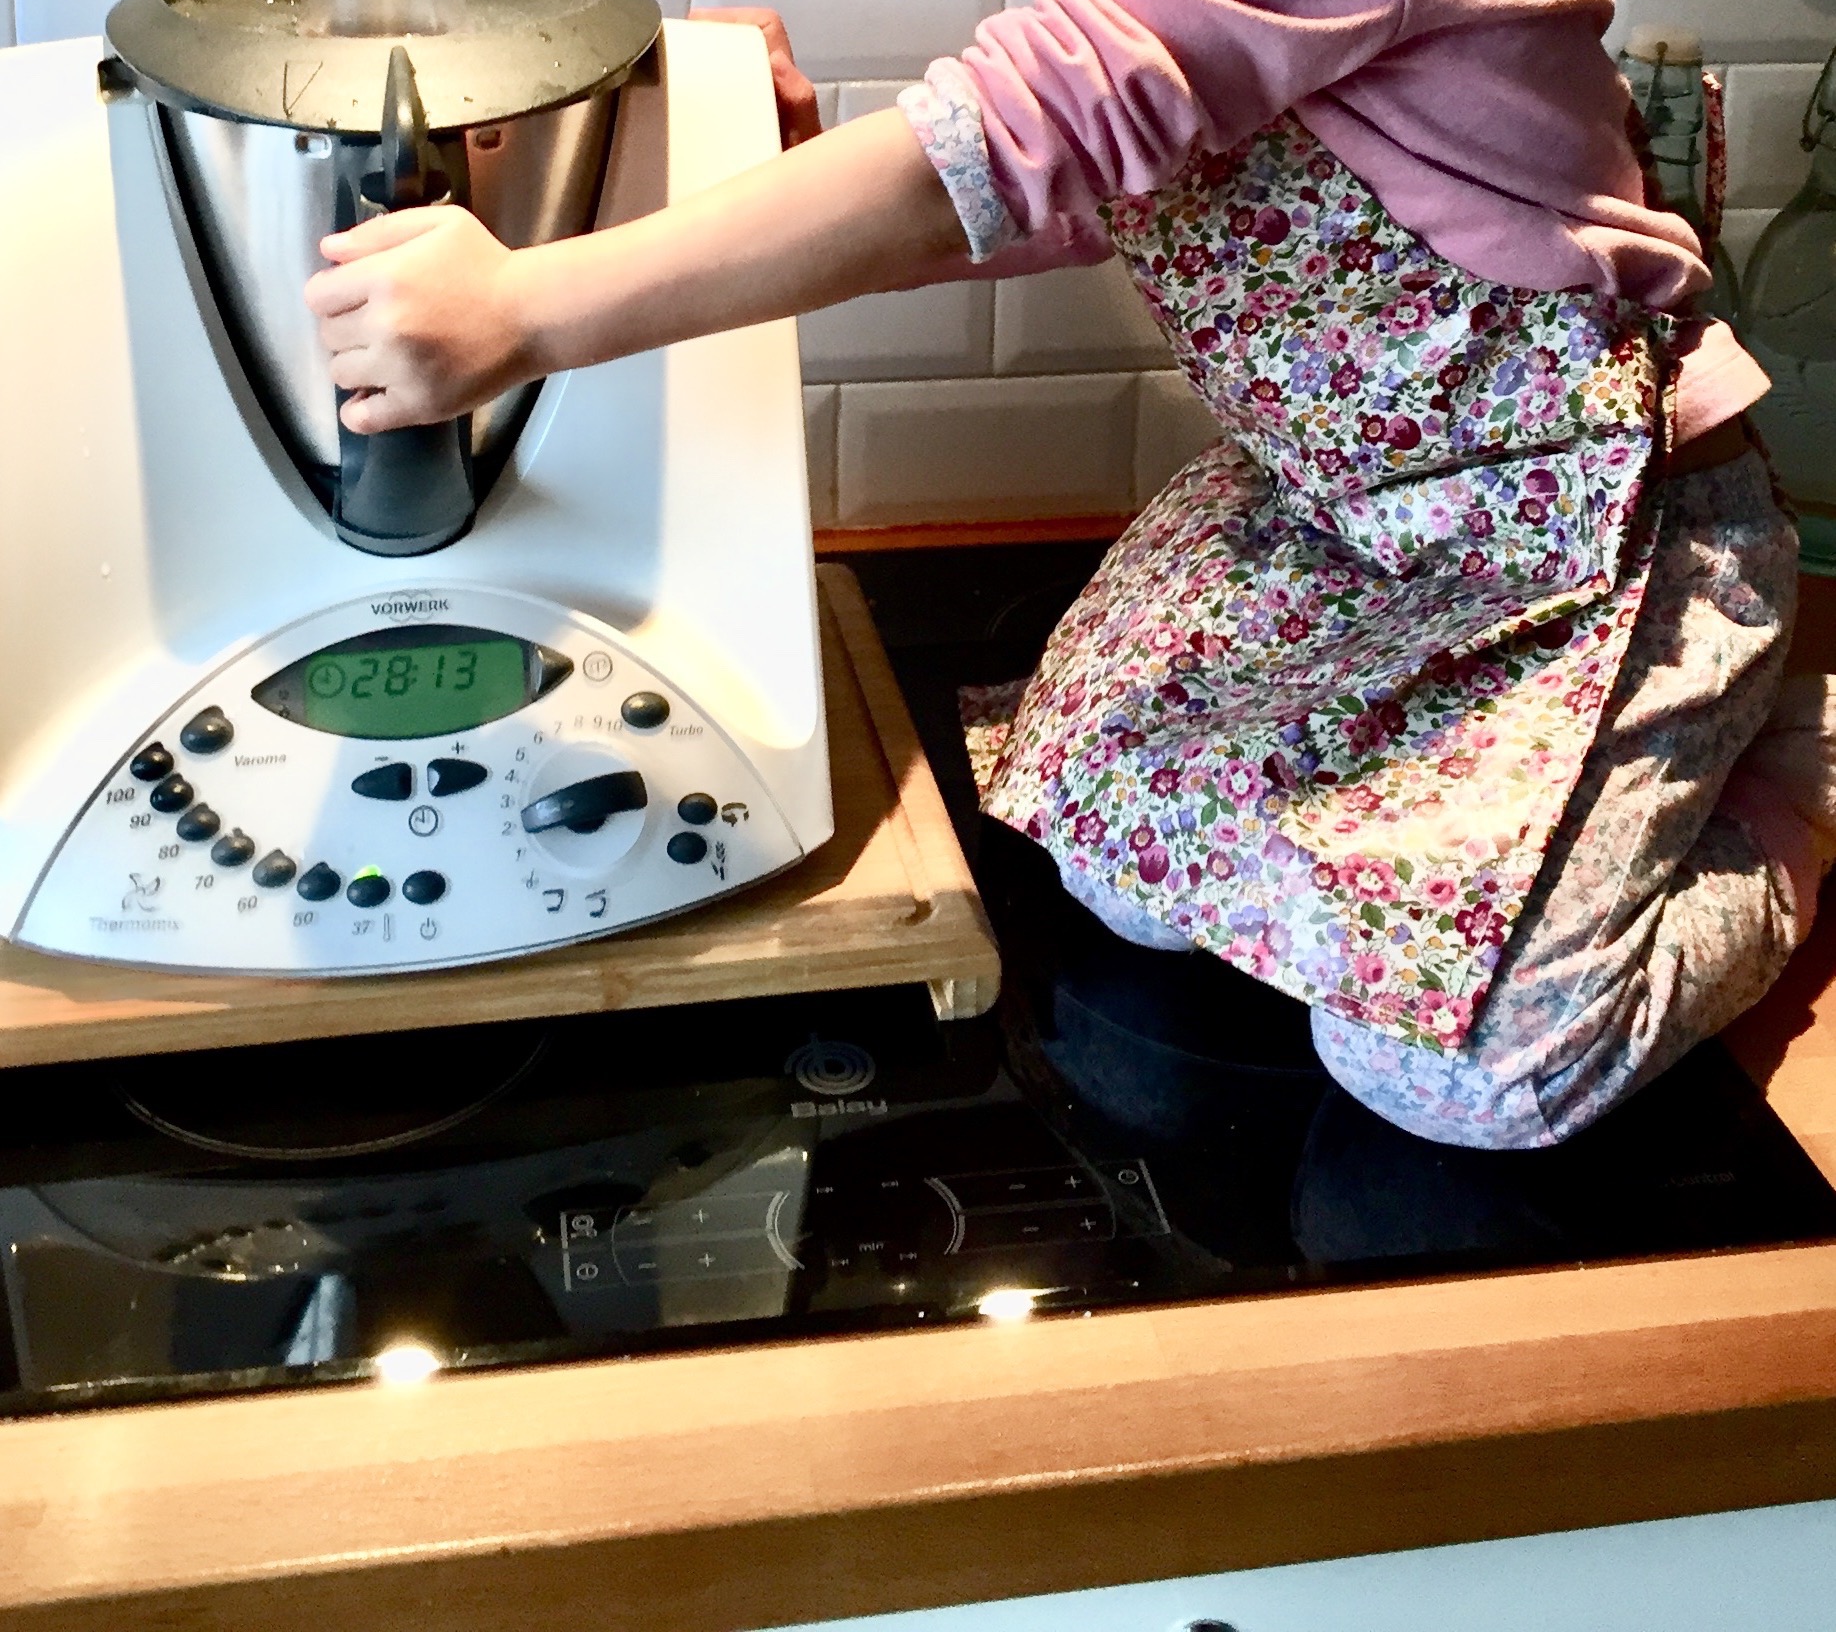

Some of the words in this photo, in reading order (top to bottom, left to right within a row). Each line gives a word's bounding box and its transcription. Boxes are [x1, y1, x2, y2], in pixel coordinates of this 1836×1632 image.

[371, 599, 450, 615] VORWERK
[607, 720, 622, 732] 10
[670, 724, 704, 737] Turbo
[533, 731, 543, 745] 6
[234, 753, 287, 768] Varoma
[505, 769, 515, 783] 4
[106, 787, 136, 805] 100
[501, 794, 510, 809] 3
[129, 813, 152, 829] 90
[502, 822, 512, 835] 2
[158, 844, 180, 860] 80
[195, 874, 214, 890] 70
[237, 895, 258, 913] 60
[352, 919, 370, 935] 37
